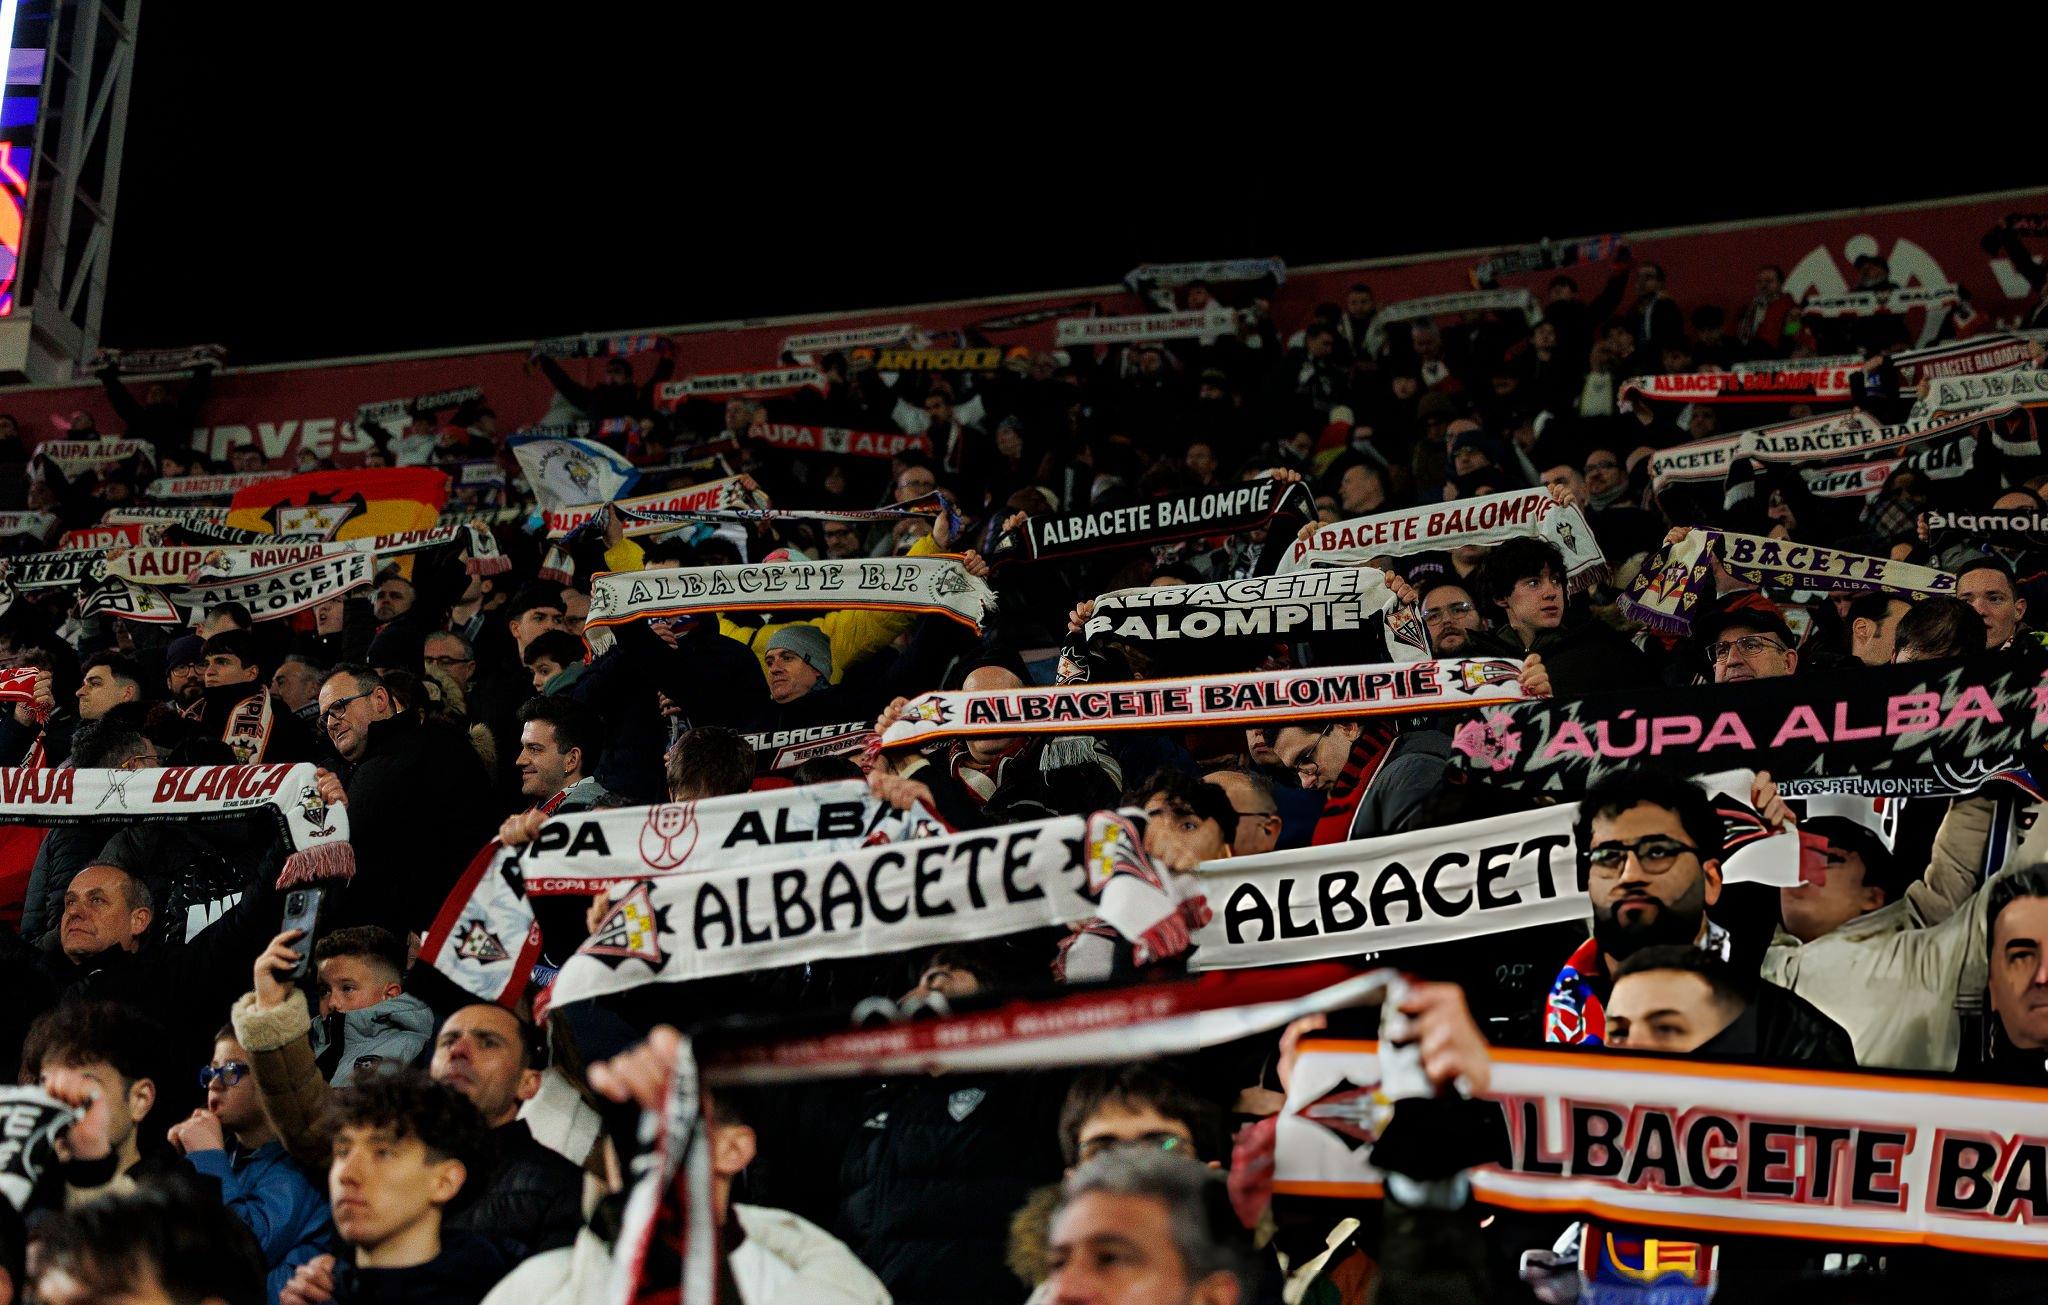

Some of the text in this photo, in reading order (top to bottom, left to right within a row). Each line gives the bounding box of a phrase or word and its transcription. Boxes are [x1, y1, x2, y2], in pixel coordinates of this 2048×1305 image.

[1655, 373, 1738, 391] ALBACETE
[746, 424, 816, 447] AUPA
[1756, 427, 1875, 453] ALBACETE
[1042, 478, 1270, 547] ALBACETE BALOMPIÉ
[251, 544, 323, 569] NAVAJA
[374, 526, 455, 550] BLANCA
[1294, 517, 1416, 564] ALBACETE
[203, 554, 366, 604] ALBACETE
[629, 562, 922, 605] ALBACETE B.P.
[1097, 567, 1364, 609] ALBACETE
[1803, 576, 1872, 592] EL ALBA
[1086, 594, 1363, 640] BALOMPIÉ
[965, 661, 1442, 725] ALBACETE BALOMPIÉ
[747, 721, 866, 750] ALBACETE
[1552, 684, 2006, 760] AÚPA ALBA
[152, 764, 296, 804] BLANCA
[543, 878, 586, 891] COPA
[694, 828, 1047, 950] ALBACETE
